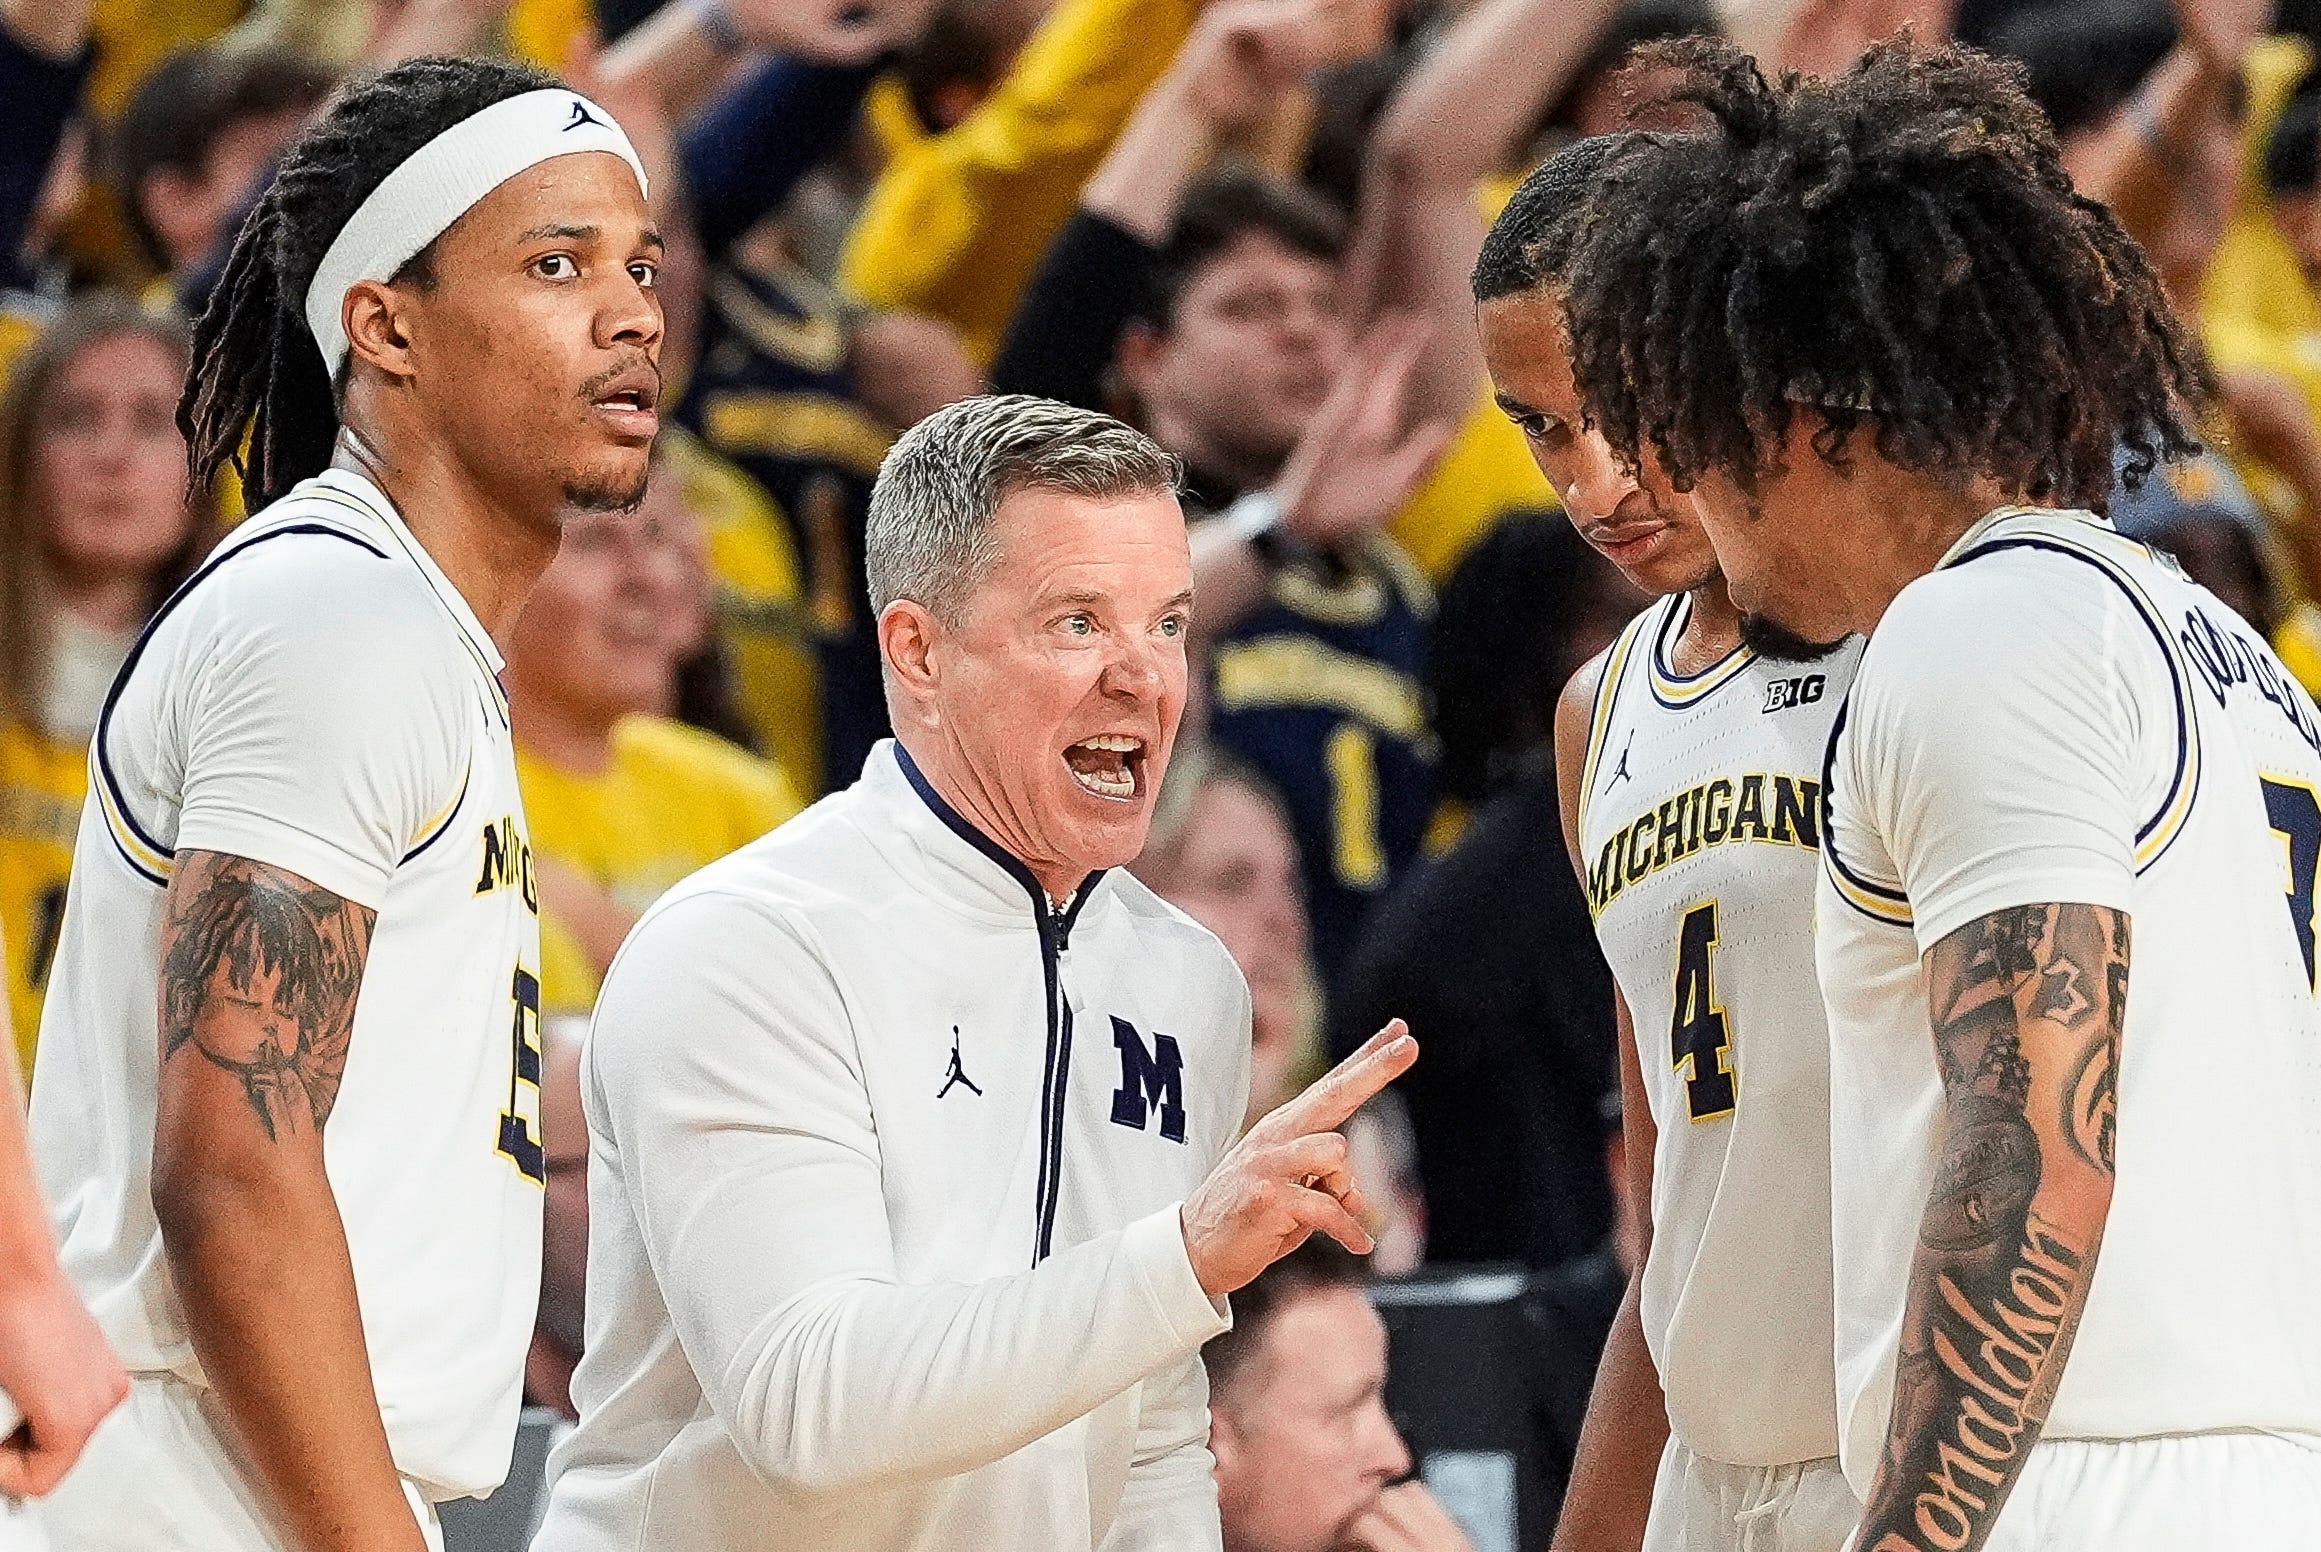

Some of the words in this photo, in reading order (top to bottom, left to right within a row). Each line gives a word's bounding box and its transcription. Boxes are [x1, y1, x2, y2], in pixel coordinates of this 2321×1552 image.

[1587, 772, 1822, 913] MICHIGAN
[1108, 1014, 1186, 1144] M
[1670, 897, 1737, 1124] 4
[1870, 1210, 2080, 1552] onaldson
